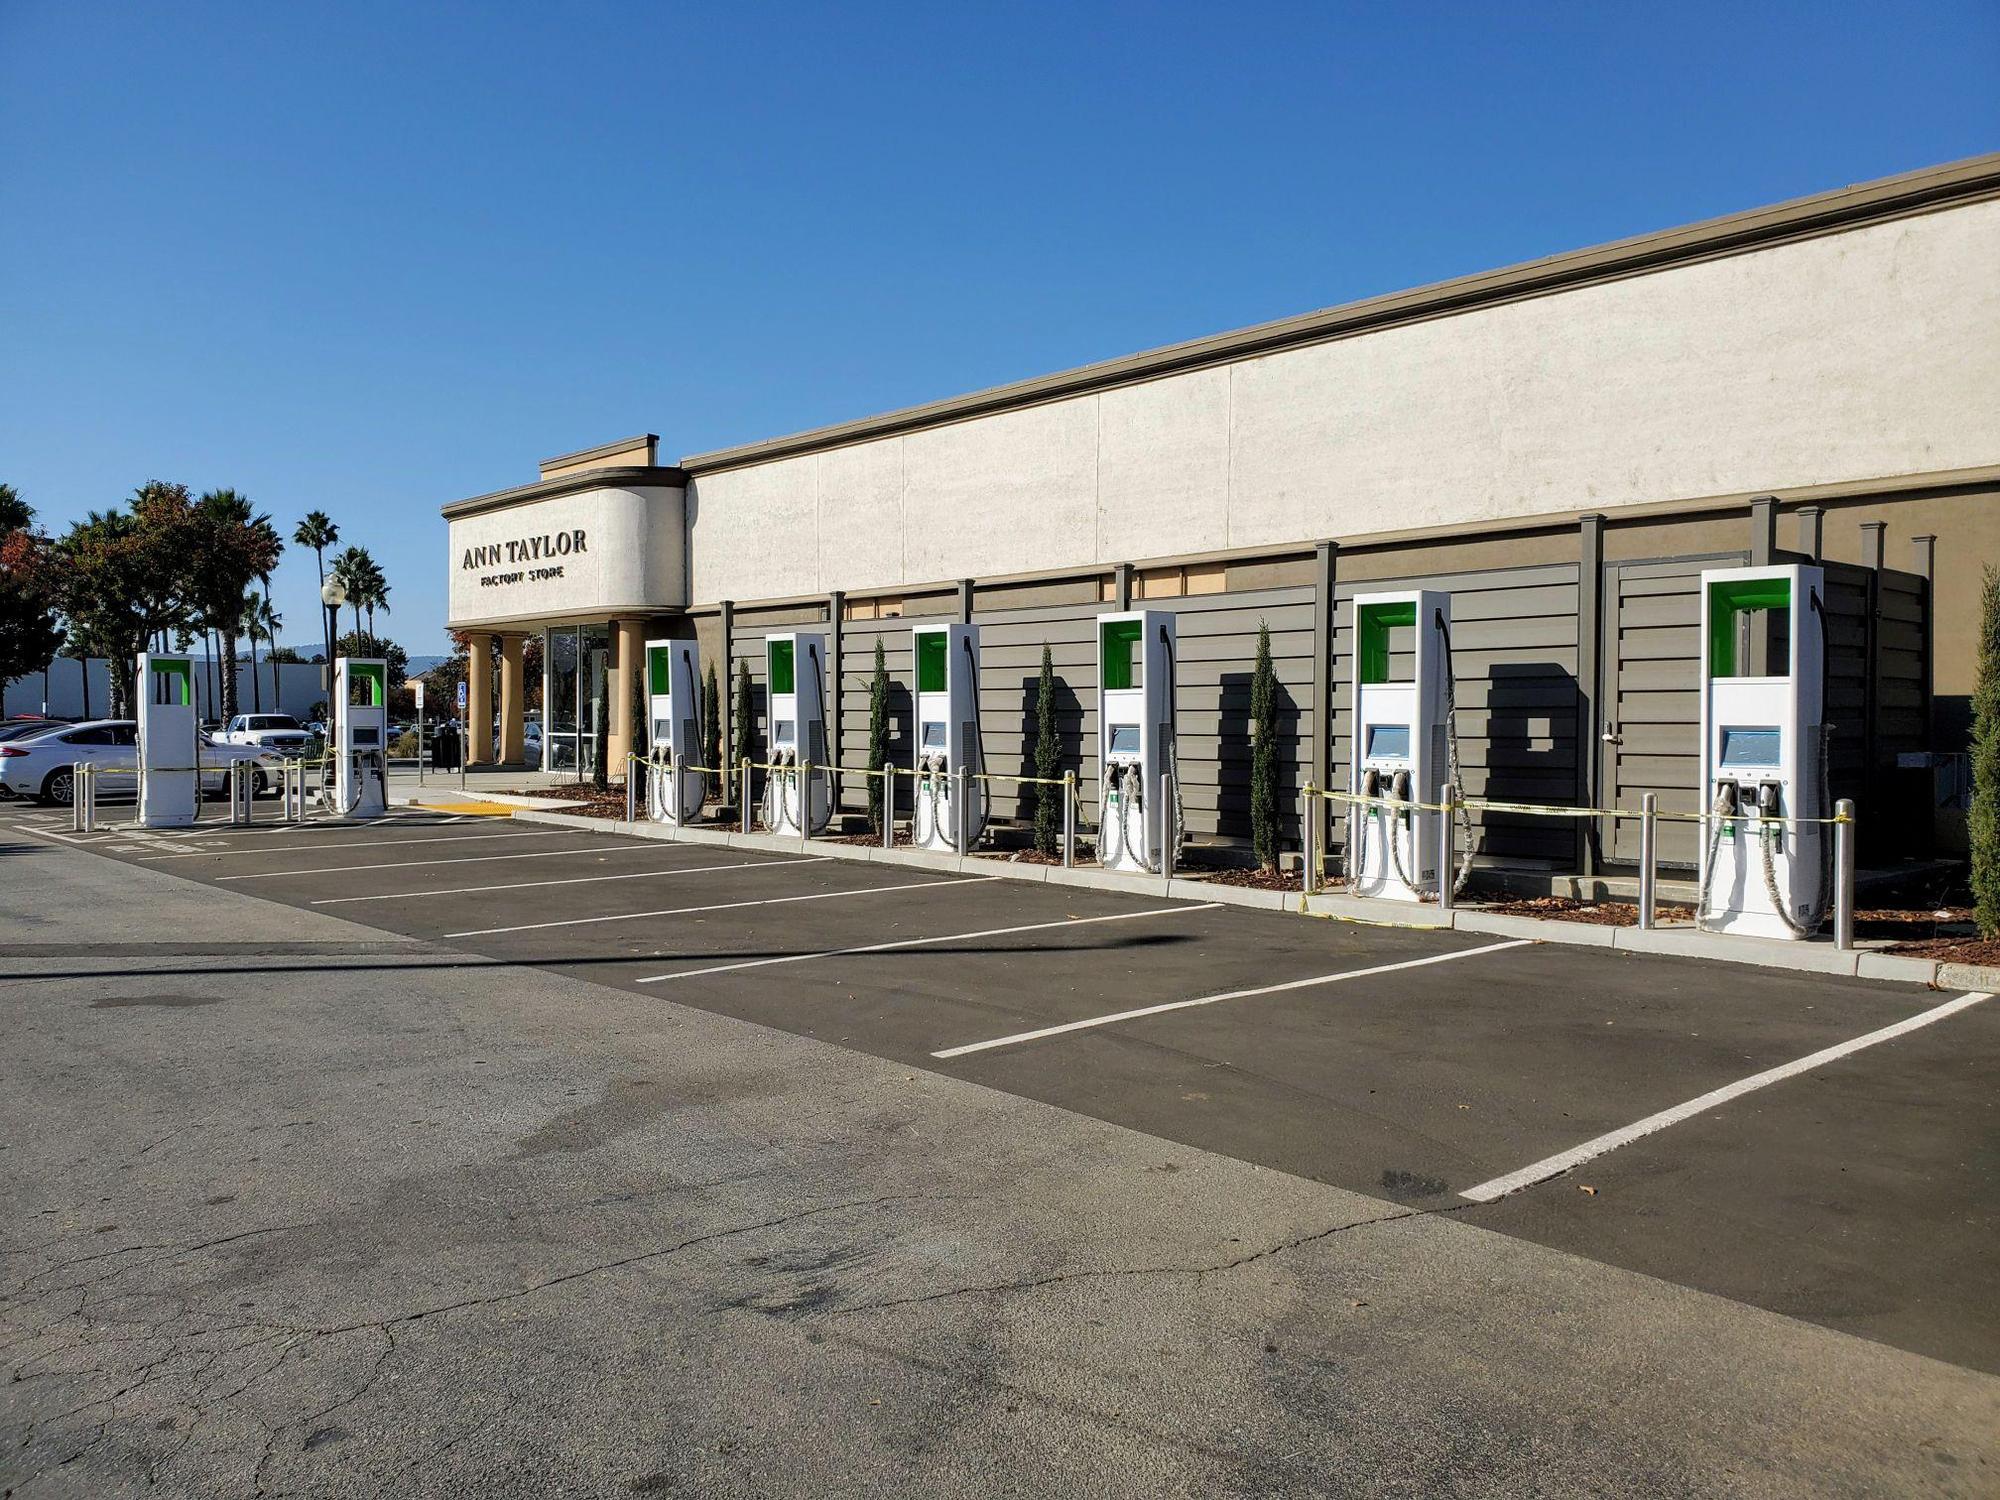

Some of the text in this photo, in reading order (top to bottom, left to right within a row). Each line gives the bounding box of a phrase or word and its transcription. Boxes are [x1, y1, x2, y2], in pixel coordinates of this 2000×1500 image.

[463, 529, 588, 570] ANN TAYLOR
[480, 566, 565, 587] FACTORY STORE
